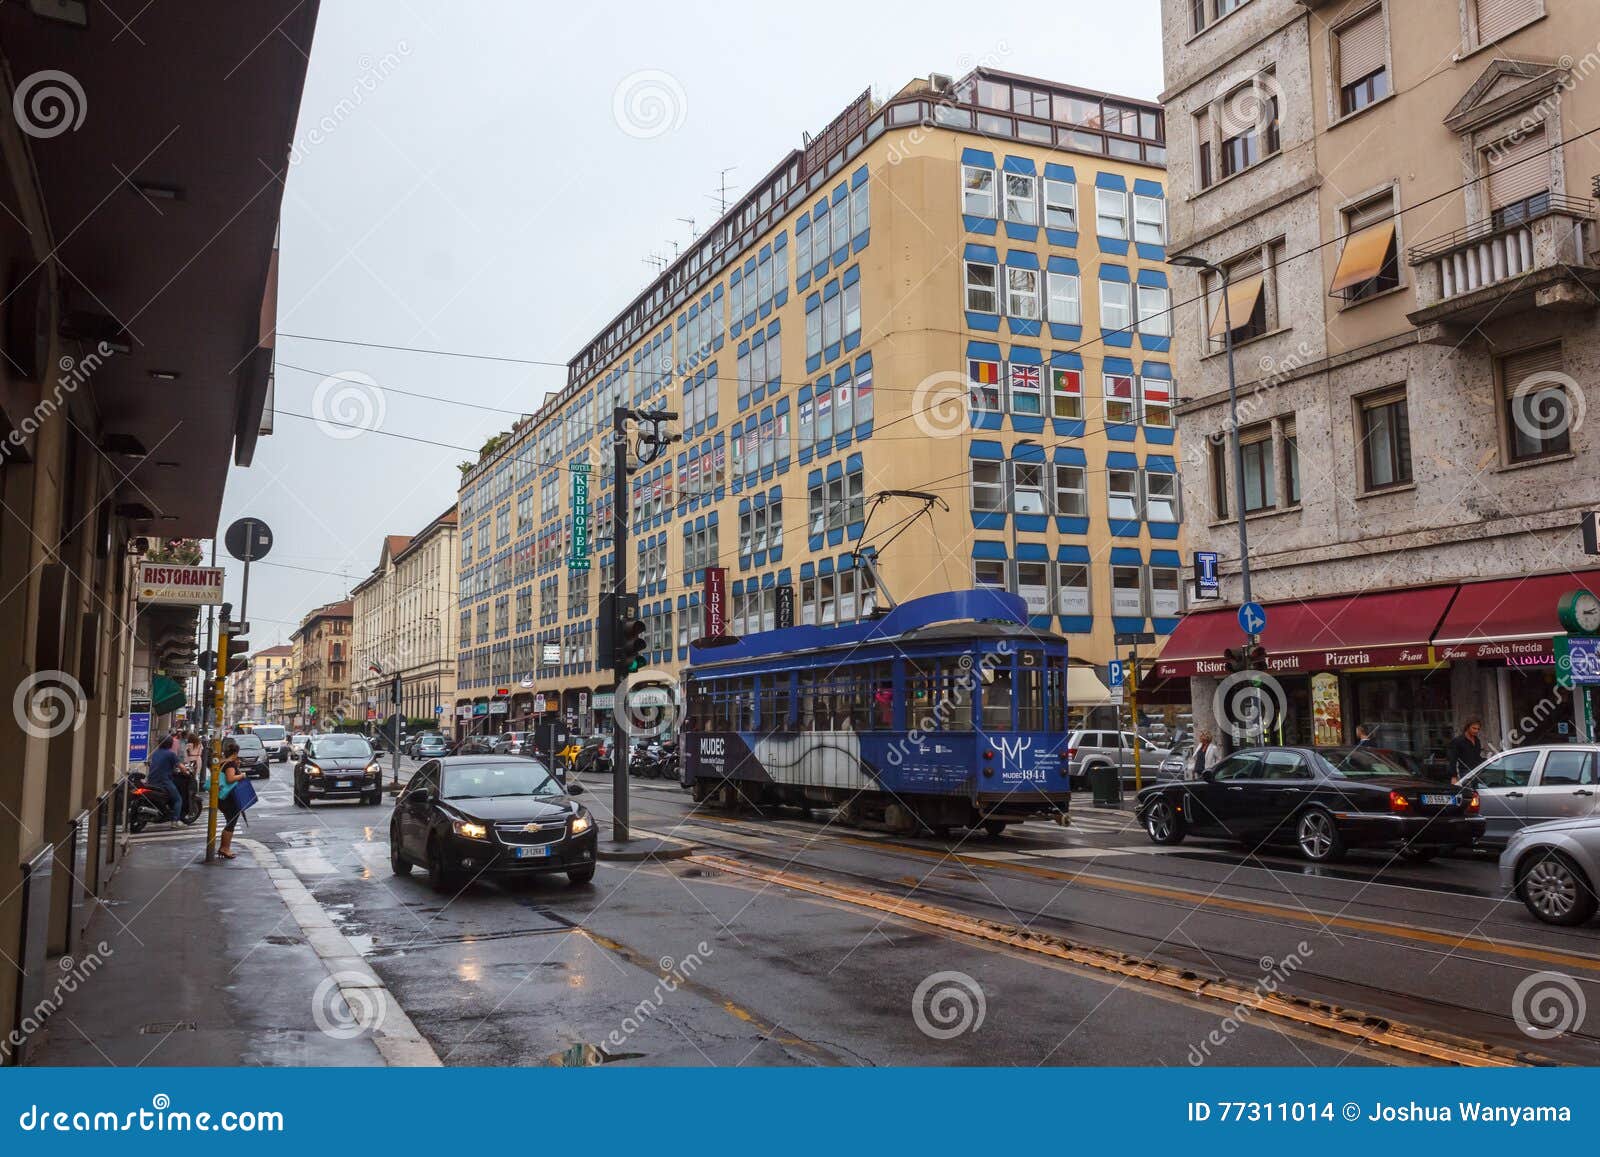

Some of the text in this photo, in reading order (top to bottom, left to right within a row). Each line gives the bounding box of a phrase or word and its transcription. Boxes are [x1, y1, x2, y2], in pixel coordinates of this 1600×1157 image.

[575, 475, 585, 556] KEBHOTEL
[144, 568, 221, 586] RISTORANTE
[711, 571, 720, 635] LIBRER
[1023, 651, 1034, 666] 5
[1325, 651, 1370, 666] Pizzeria
[1477, 643, 1543, 657] Tavola fredda
[1265, 655, 1299, 670] Lepetit
[1111, 663, 1120, 684] P
[700, 738, 725, 756] MUDEC
